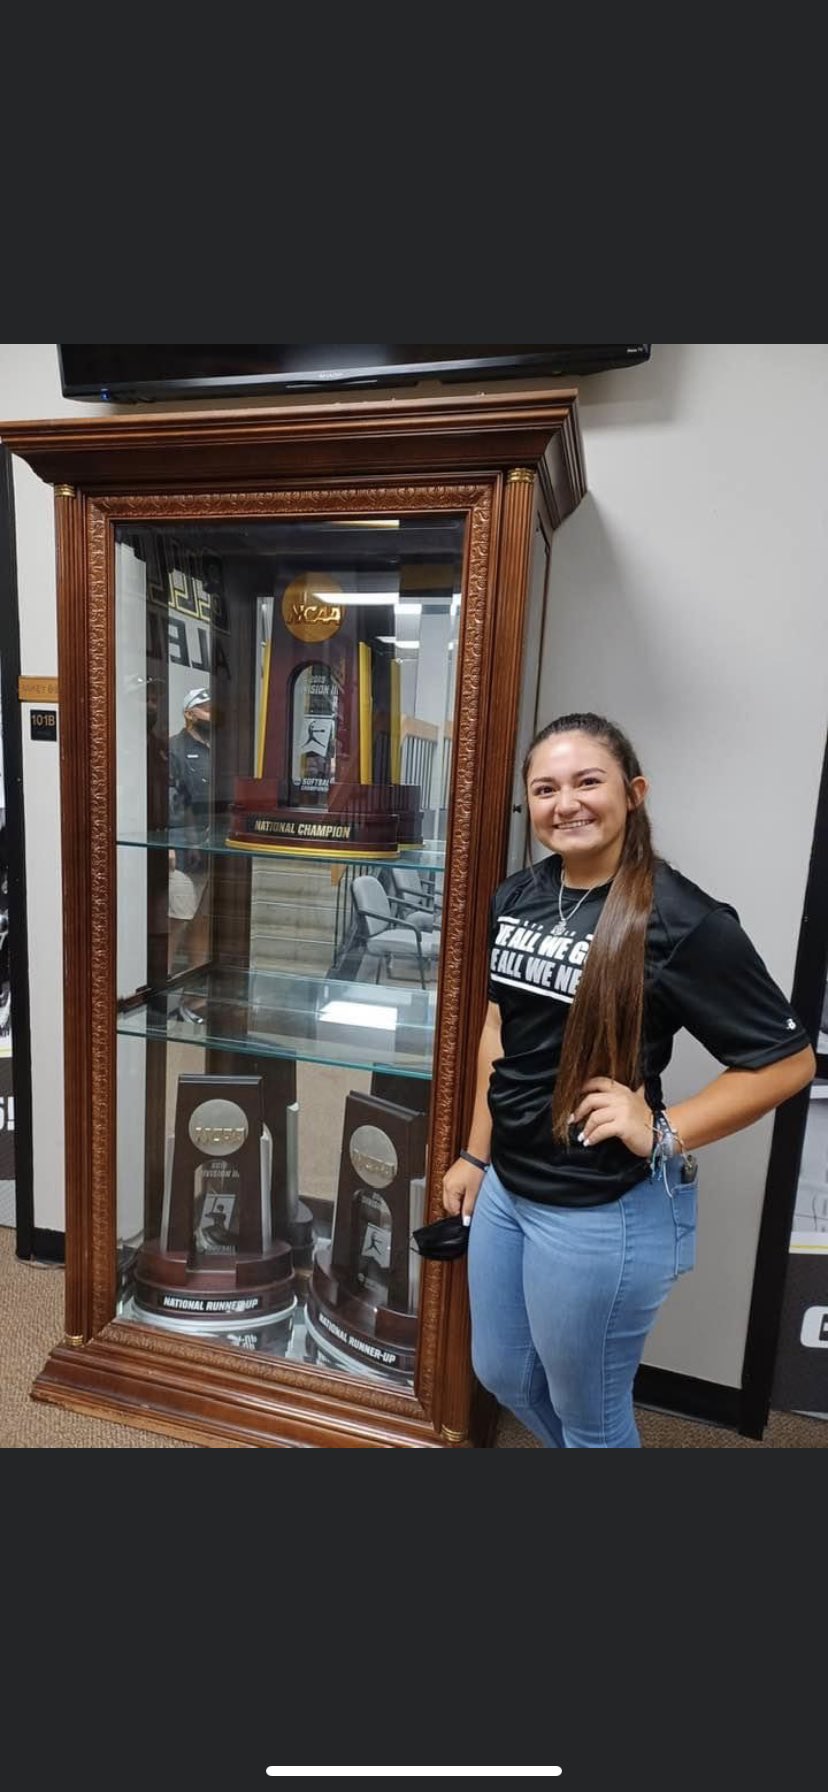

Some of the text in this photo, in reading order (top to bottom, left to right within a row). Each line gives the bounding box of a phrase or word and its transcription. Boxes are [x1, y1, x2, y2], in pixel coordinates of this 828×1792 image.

[32, 714, 55, 727] 101B
[254, 819, 351, 839] NATIONAL CHAMPION
[507, 926, 542, 954] ALL
[537, 934, 574, 961] WE
[568, 940, 591, 966] G
[497, 950, 525, 979] ALL
[525, 956, 557, 988] WE
[163, 1295, 204, 1311] NATIONAL
[319, 1312, 397, 1364] NATIONAL RUNNER-UP
